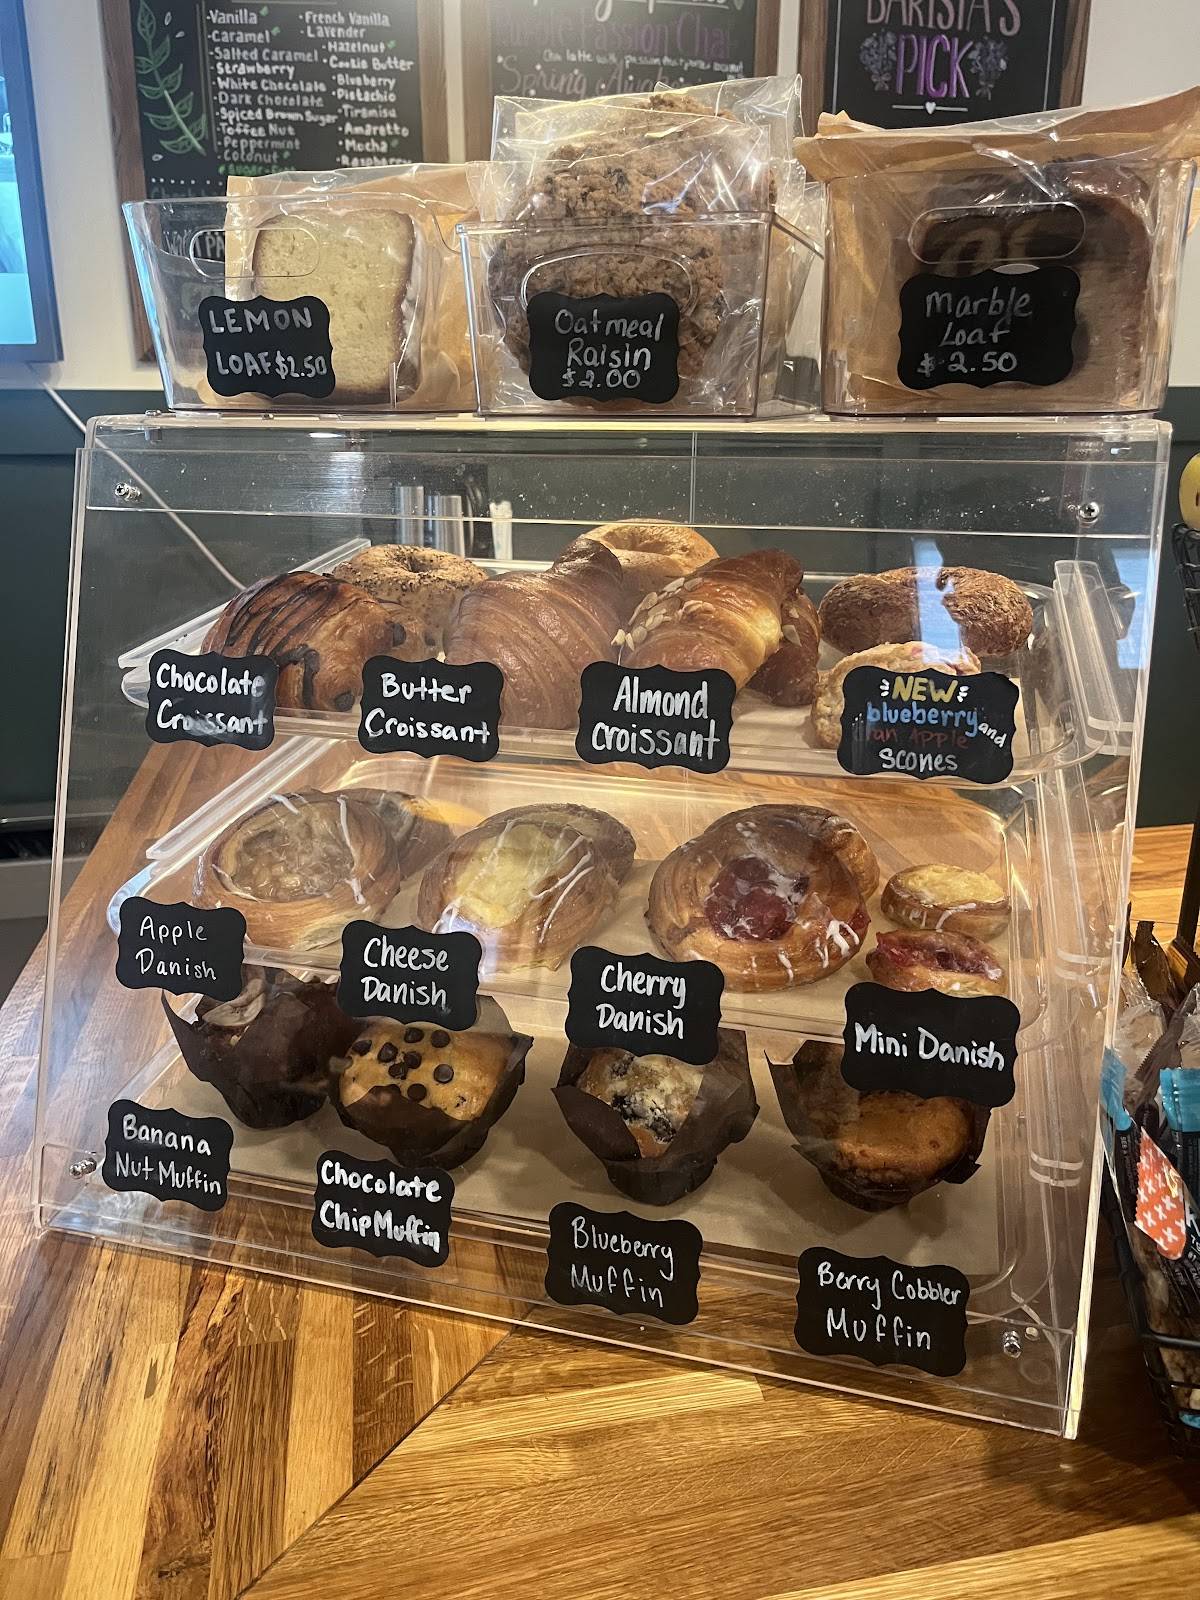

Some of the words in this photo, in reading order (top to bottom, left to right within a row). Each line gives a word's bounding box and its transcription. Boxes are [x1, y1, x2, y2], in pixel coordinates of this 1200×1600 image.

[209, 8, 258, 24] Vanilla
[305, 11, 345, 24] French
[348, 11, 391, 27] Vanilla
[307, 25, 366, 38] Lavender
[867, 0, 1021, 36] BARISTAS
[211, 29, 270, 43] Caramel
[327, 40, 386, 53] Hazelnut
[214, 46, 258, 60] Salted
[261, 48, 318, 62] Caramel
[329, 55, 369, 69] Cookie
[371, 56, 415, 71] Butter
[896, 34, 974, 98] PICK
[215, 62, 295, 80] Strawberry
[217, 77, 259, 90] White
[261, 79, 327, 92] Chocolate
[336, 73, 396, 91] Blueberry
[218, 91, 253, 105] Dark
[257, 94, 324, 107] Chocolate
[336, 87, 397, 102] Pistachio
[220, 107, 263, 125] Spiced
[304, 110, 339, 127] Sugar
[220, 122, 266, 137] Toffee
[268, 122, 296, 136] Nut
[344, 122, 409, 137] Amaretto
[223, 136, 301, 154] Peppermint
[223, 149, 279, 163] Coconut
[344, 138, 388, 152] Mocha
[208, 307, 312, 333] LEMON
[554, 308, 664, 341] Oatmeal
[938, 318, 1011, 347] Loaf
[215, 351, 271, 377] LOAF
[275, 350, 328, 380] $2.50
[567, 337, 651, 371] Raisin
[561, 367, 641, 389] $2.00
[156, 662, 266, 698] Chocolate
[380, 672, 473, 704] Butter
[891, 675, 959, 703] NEW
[612, 675, 709, 719] Almond
[156, 698, 269, 736] Croissant
[364, 707, 491, 744] Croissant
[866, 700, 979, 738] blueberry
[977, 721, 1008, 748] and
[139, 915, 207, 946] Apple
[135, 947, 217, 981] Danish
[363, 934, 450, 972] Cheese
[360, 976, 448, 1011] Danish
[600, 961, 686, 1010] Cherry
[595, 1003, 685, 1040] Danish
[854, 1021, 908, 1058] Mini
[917, 1026, 1005, 1072] Danish
[122, 1113, 212, 1156] Banana
[115, 1151, 155, 1181] Nut
[158, 1160, 222, 1196] Muffin
[321, 1159, 443, 1203] Chocolate
[319, 1199, 372, 1238] Chip
[373, 1209, 441, 1254] Muffin
[571, 1215, 674, 1282] Blueberry
[570, 1263, 664, 1308] Muffin
[817, 1261, 881, 1311] Berry
[891, 1269, 962, 1305] Cobbler
[826, 1307, 931, 1351] Muffin
